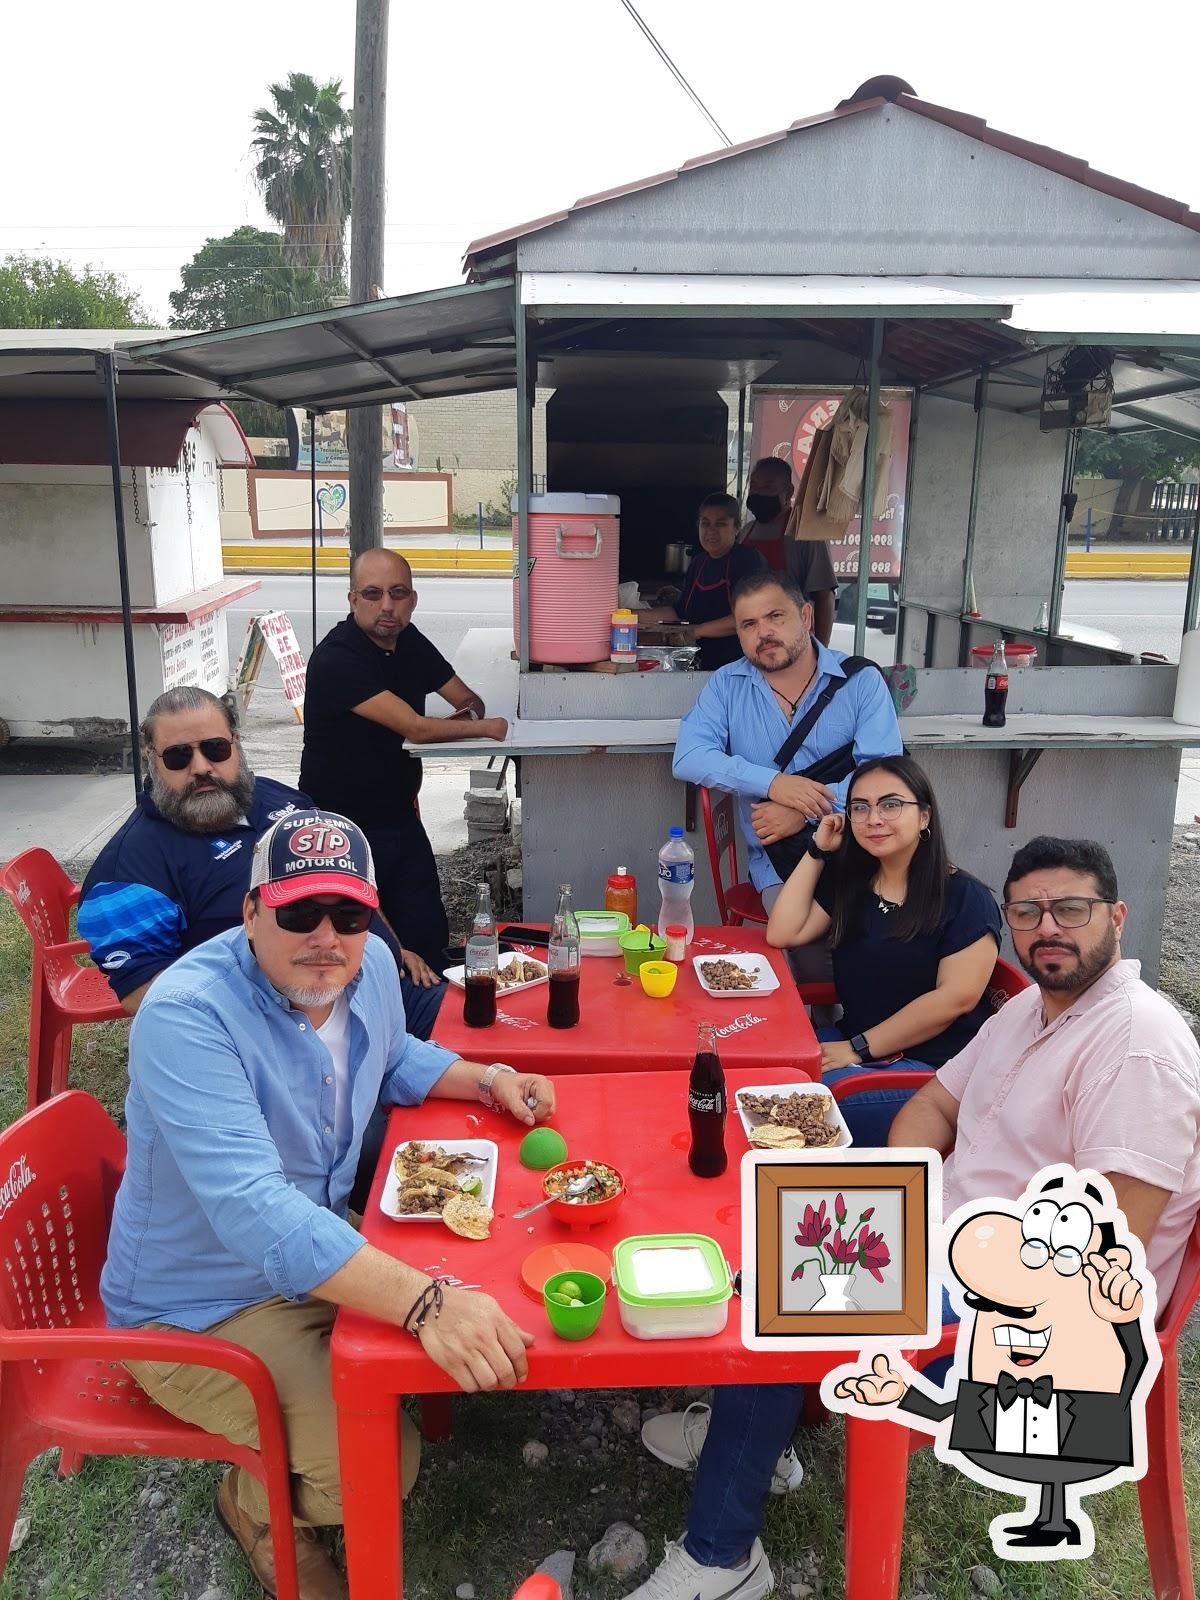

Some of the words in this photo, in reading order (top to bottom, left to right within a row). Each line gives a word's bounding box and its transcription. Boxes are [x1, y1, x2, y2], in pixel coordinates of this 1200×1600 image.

[277, 635, 292, 654] DE
[278, 650, 307, 676] CARNE
[283, 815, 353, 832] SUPREME
[297, 826, 344, 851] STP
[285, 858, 335, 873] MOTOR
[338, 858, 358, 873] OIL
